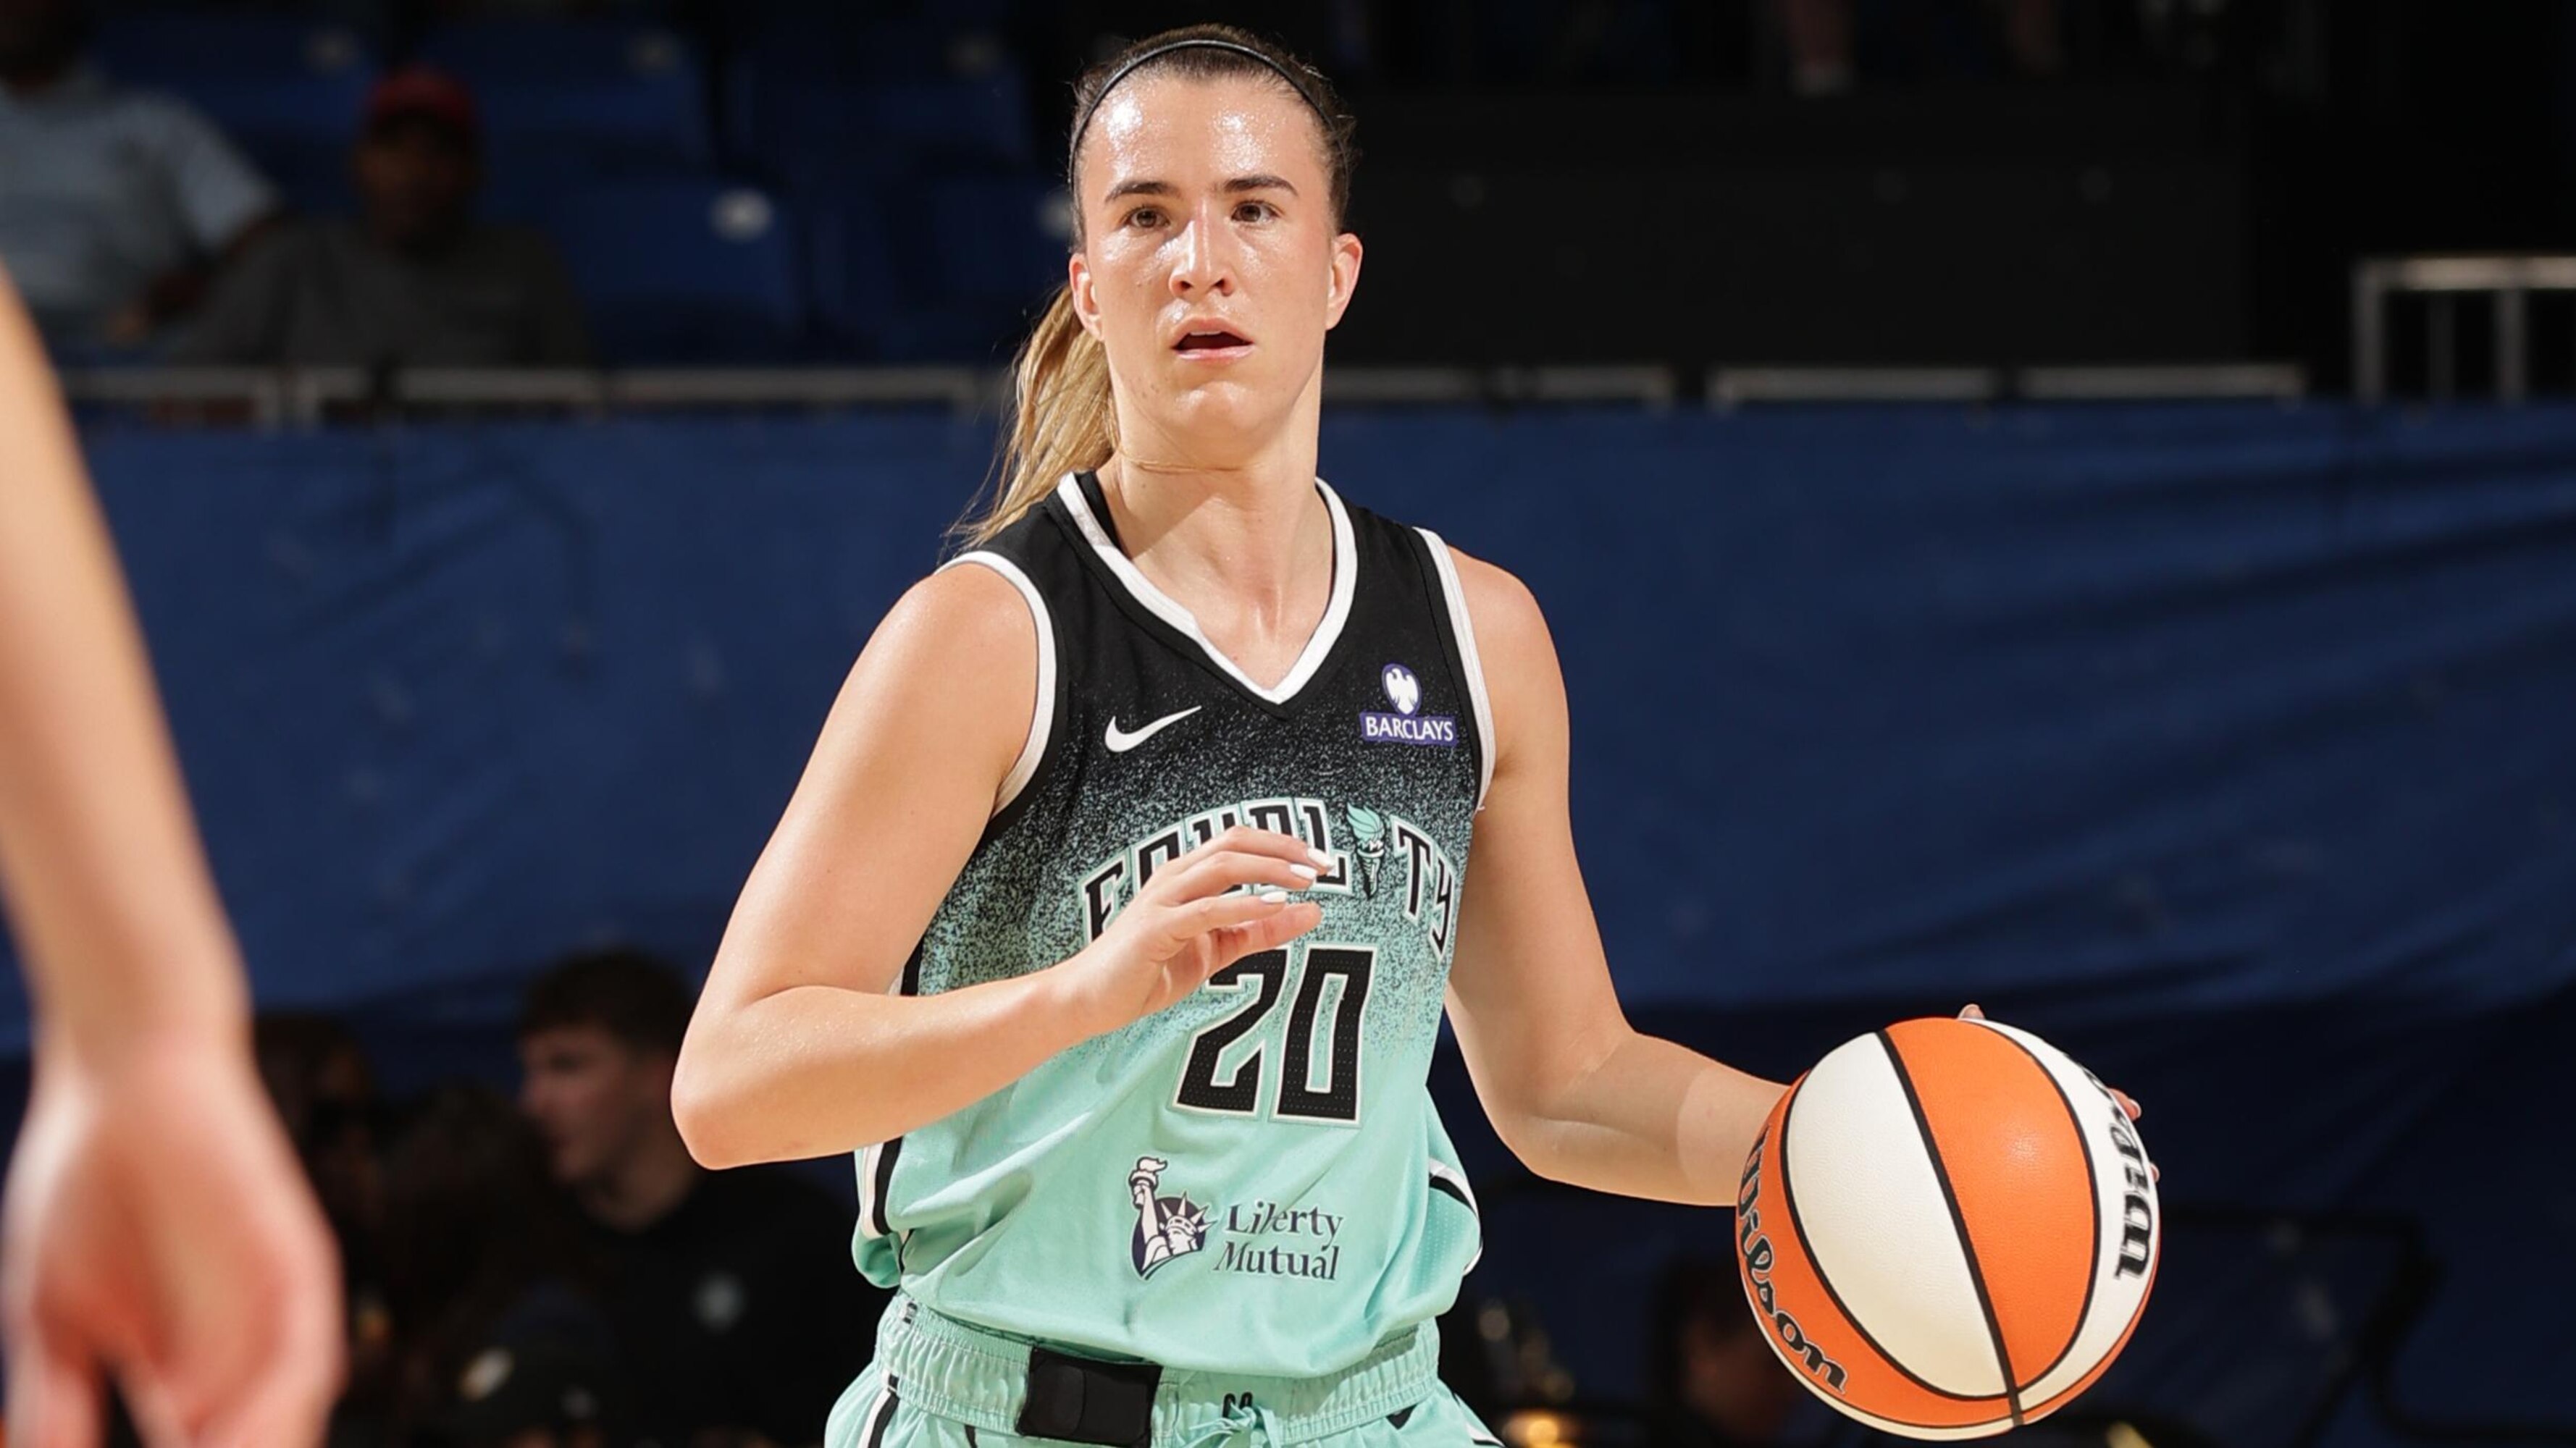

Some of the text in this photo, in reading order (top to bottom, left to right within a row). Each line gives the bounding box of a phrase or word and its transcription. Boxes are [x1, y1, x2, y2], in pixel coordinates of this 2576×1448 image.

[1365, 715, 1454, 742] BARCLAYS
[1172, 943, 1377, 1121] 20
[1226, 1200, 1344, 1252] Liberty
[2073, 1058, 2153, 1280] Wils
[1212, 1239, 1341, 1281] Mutual
[1739, 1122, 1847, 1395] Wilson
